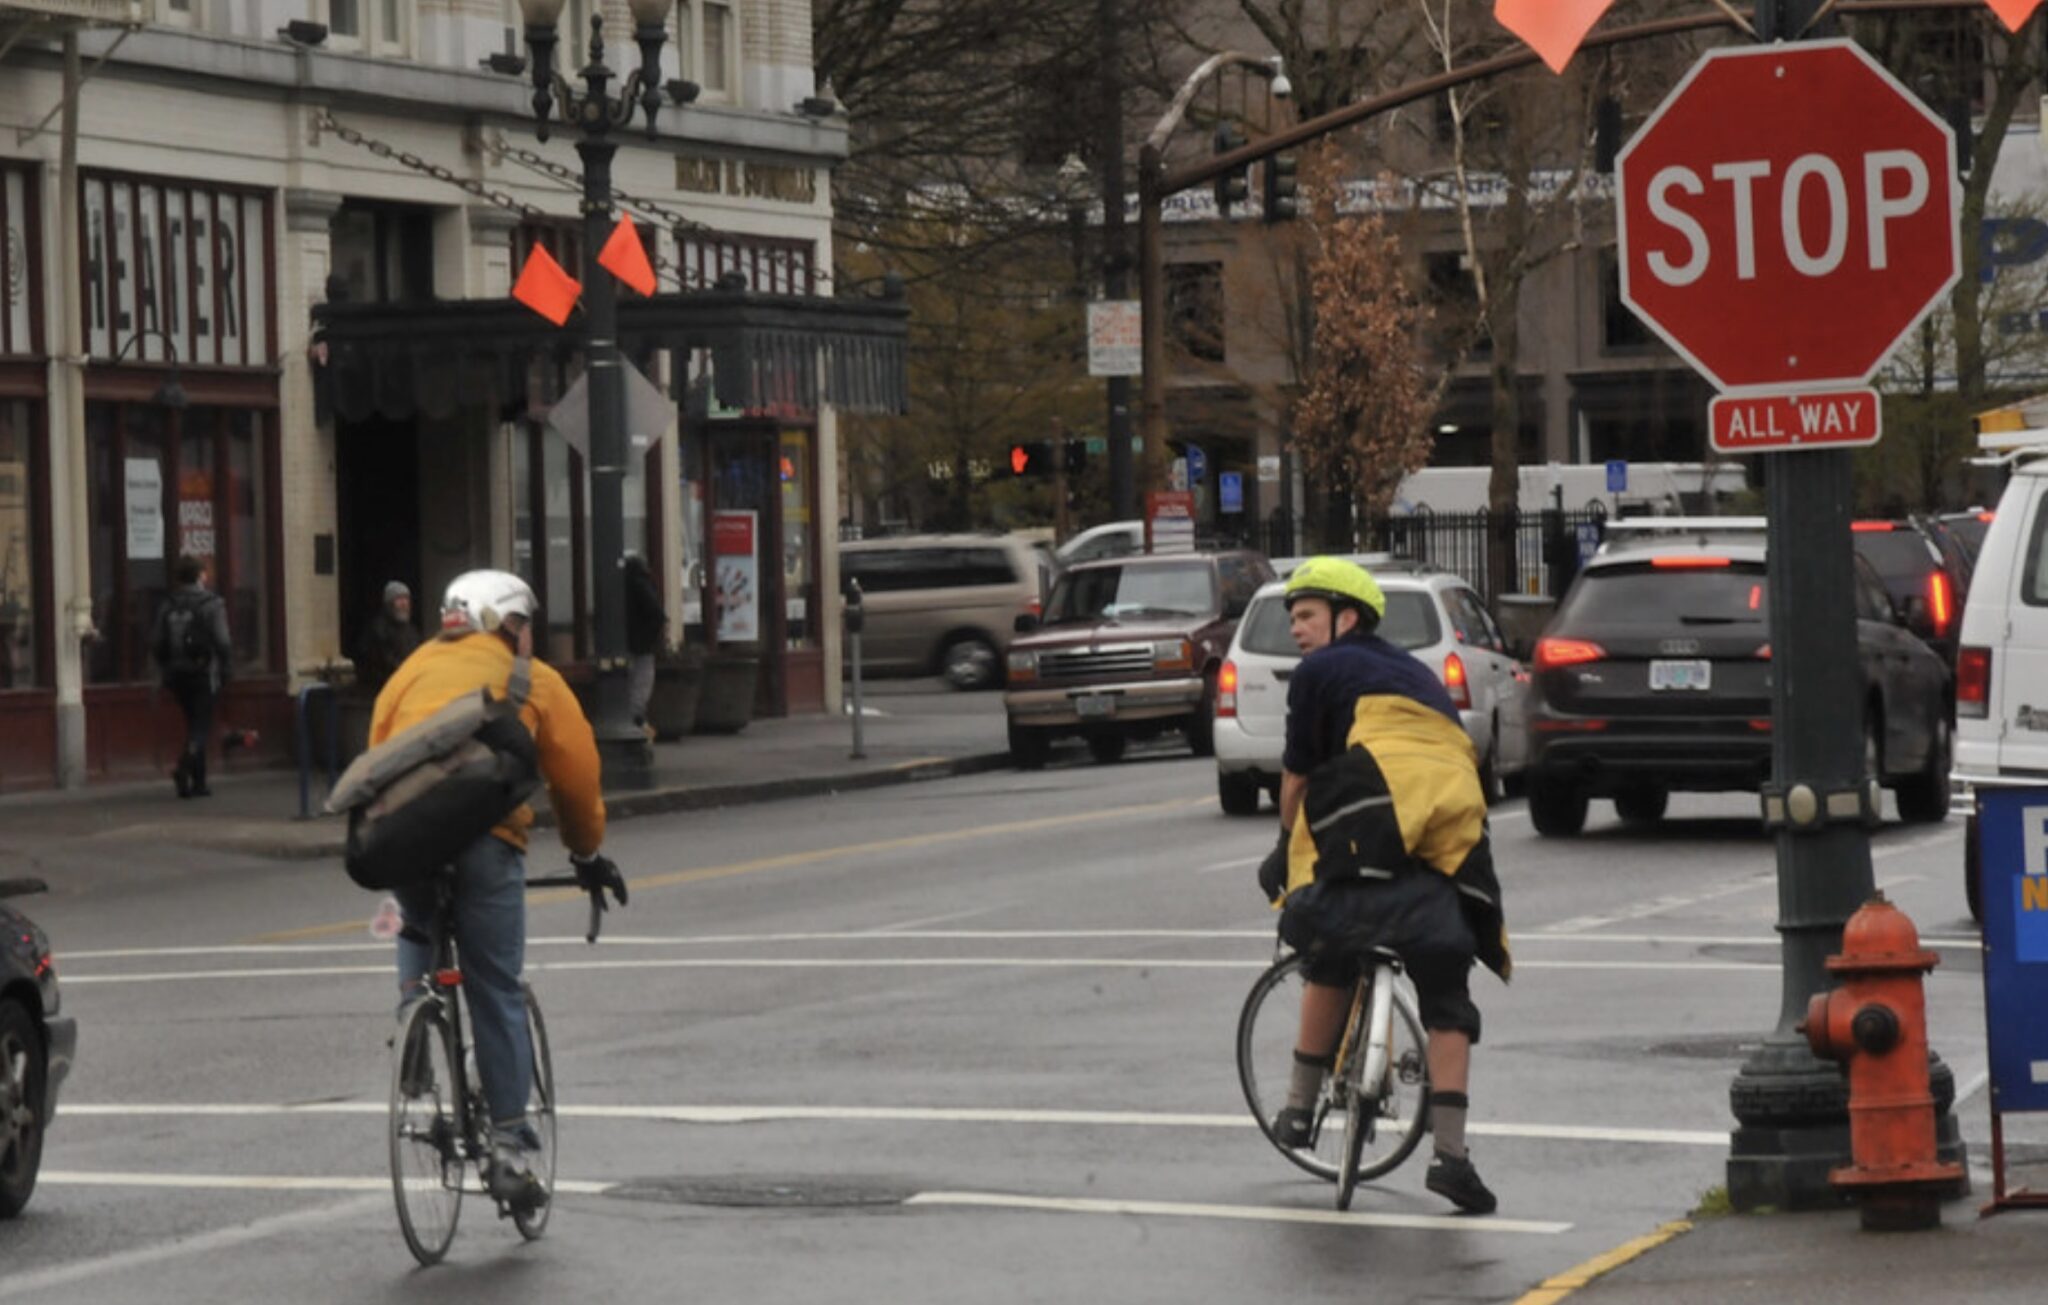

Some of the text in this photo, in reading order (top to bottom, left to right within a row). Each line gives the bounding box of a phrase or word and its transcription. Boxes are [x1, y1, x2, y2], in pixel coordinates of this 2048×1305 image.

[1647, 149, 1929, 287] STOP
[1729, 401, 1861, 439] ALL WAY
